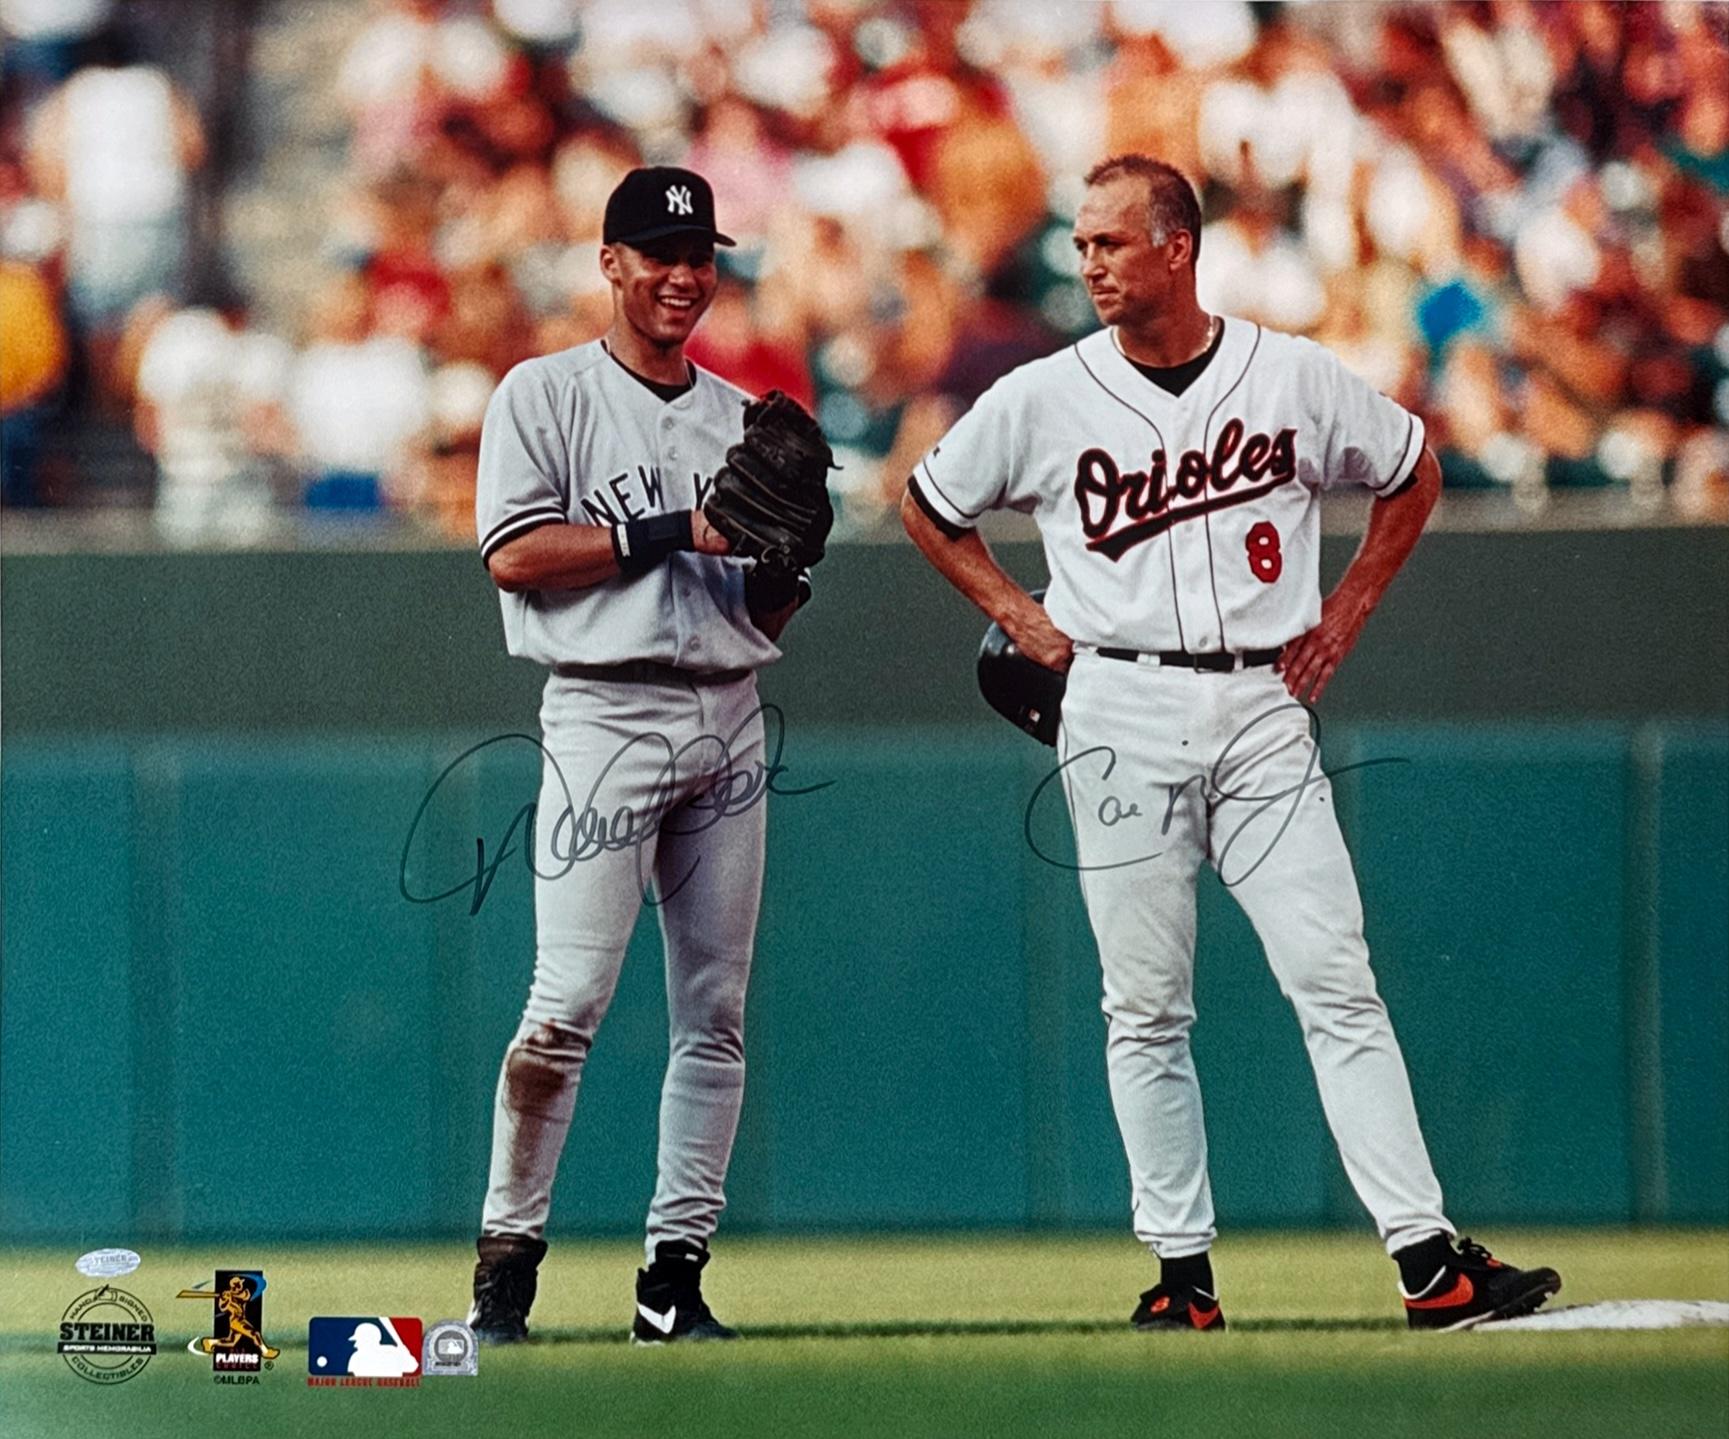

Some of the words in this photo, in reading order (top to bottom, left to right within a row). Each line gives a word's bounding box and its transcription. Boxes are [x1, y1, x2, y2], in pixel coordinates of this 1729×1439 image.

[665, 184, 694, 215] NY
[580, 465, 664, 527] NEW
[1075, 417, 1298, 550] Orioles
[1245, 520, 1283, 584] 8
